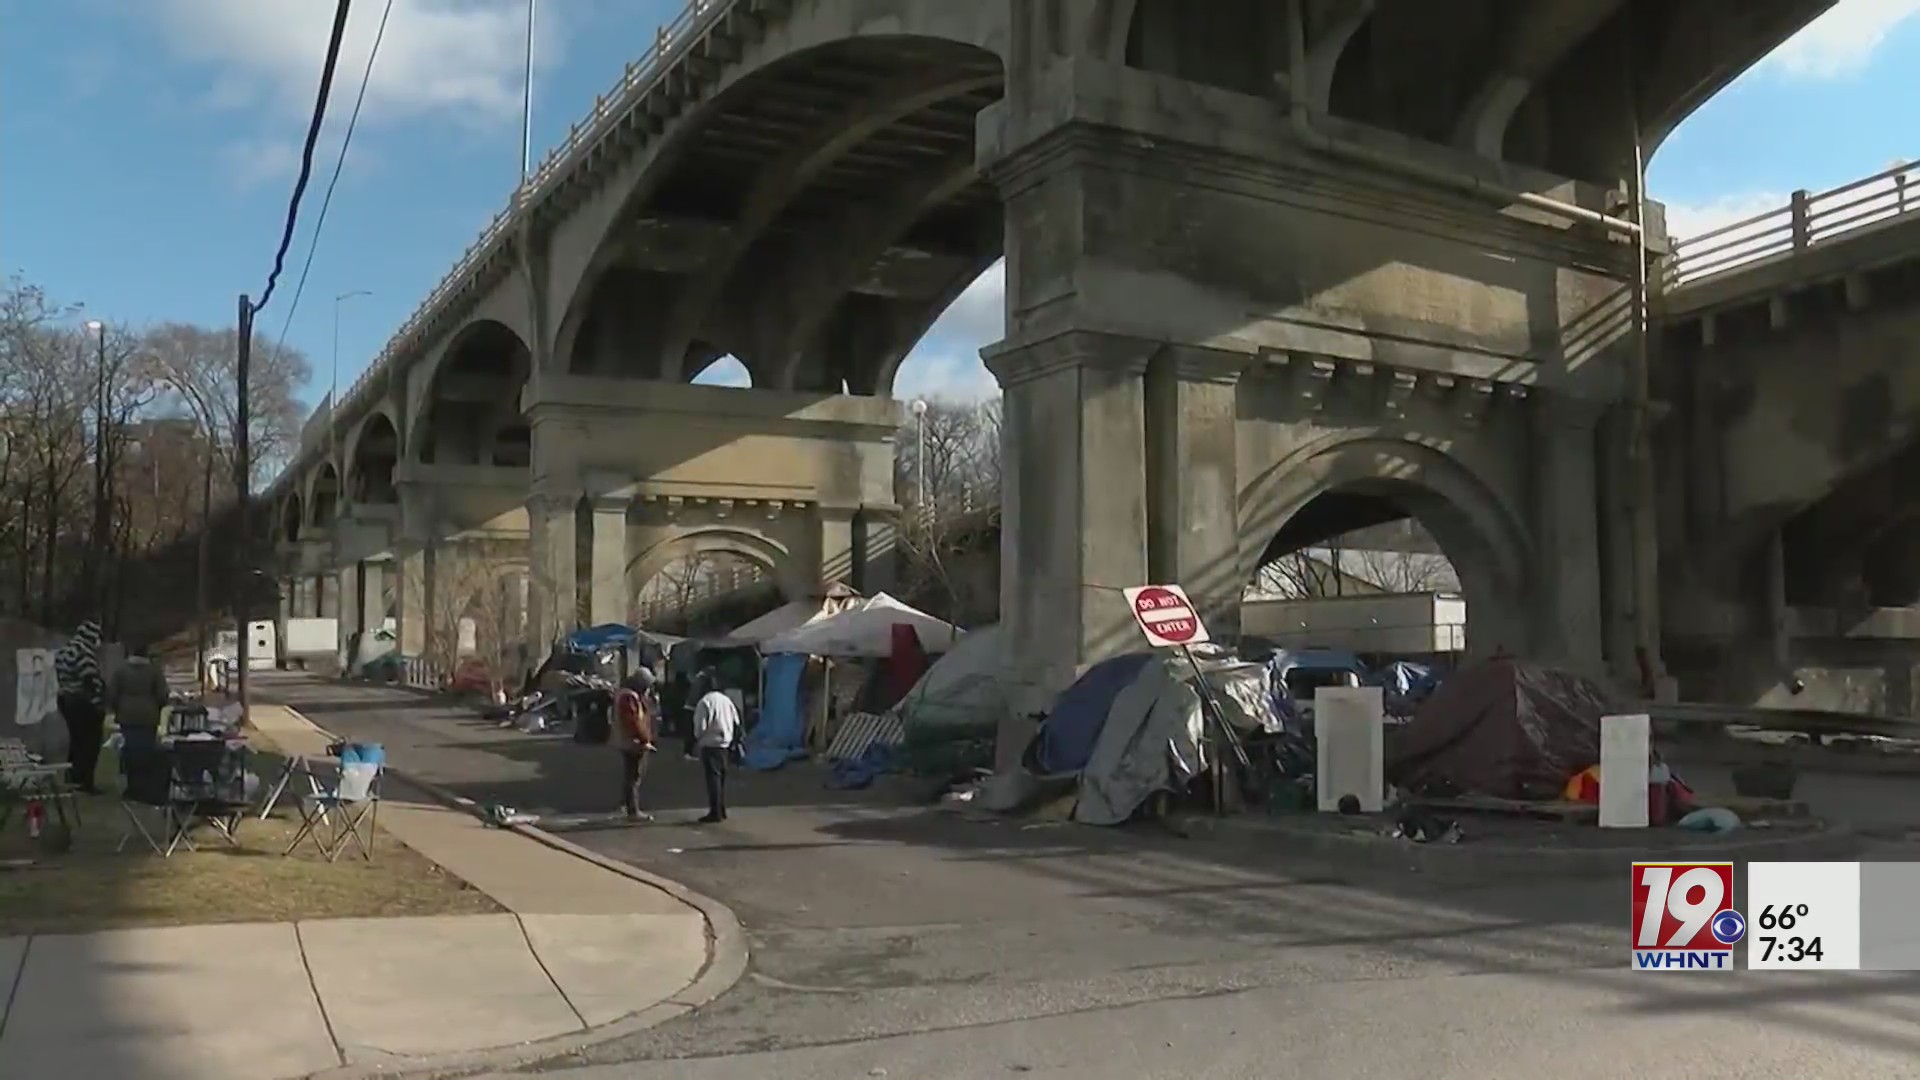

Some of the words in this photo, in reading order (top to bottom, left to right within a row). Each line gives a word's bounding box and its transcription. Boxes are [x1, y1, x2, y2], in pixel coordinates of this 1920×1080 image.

[1138, 598, 1155, 609] DO
[1158, 595, 1180, 607] NOT
[1156, 620, 1192, 634] ENTER
